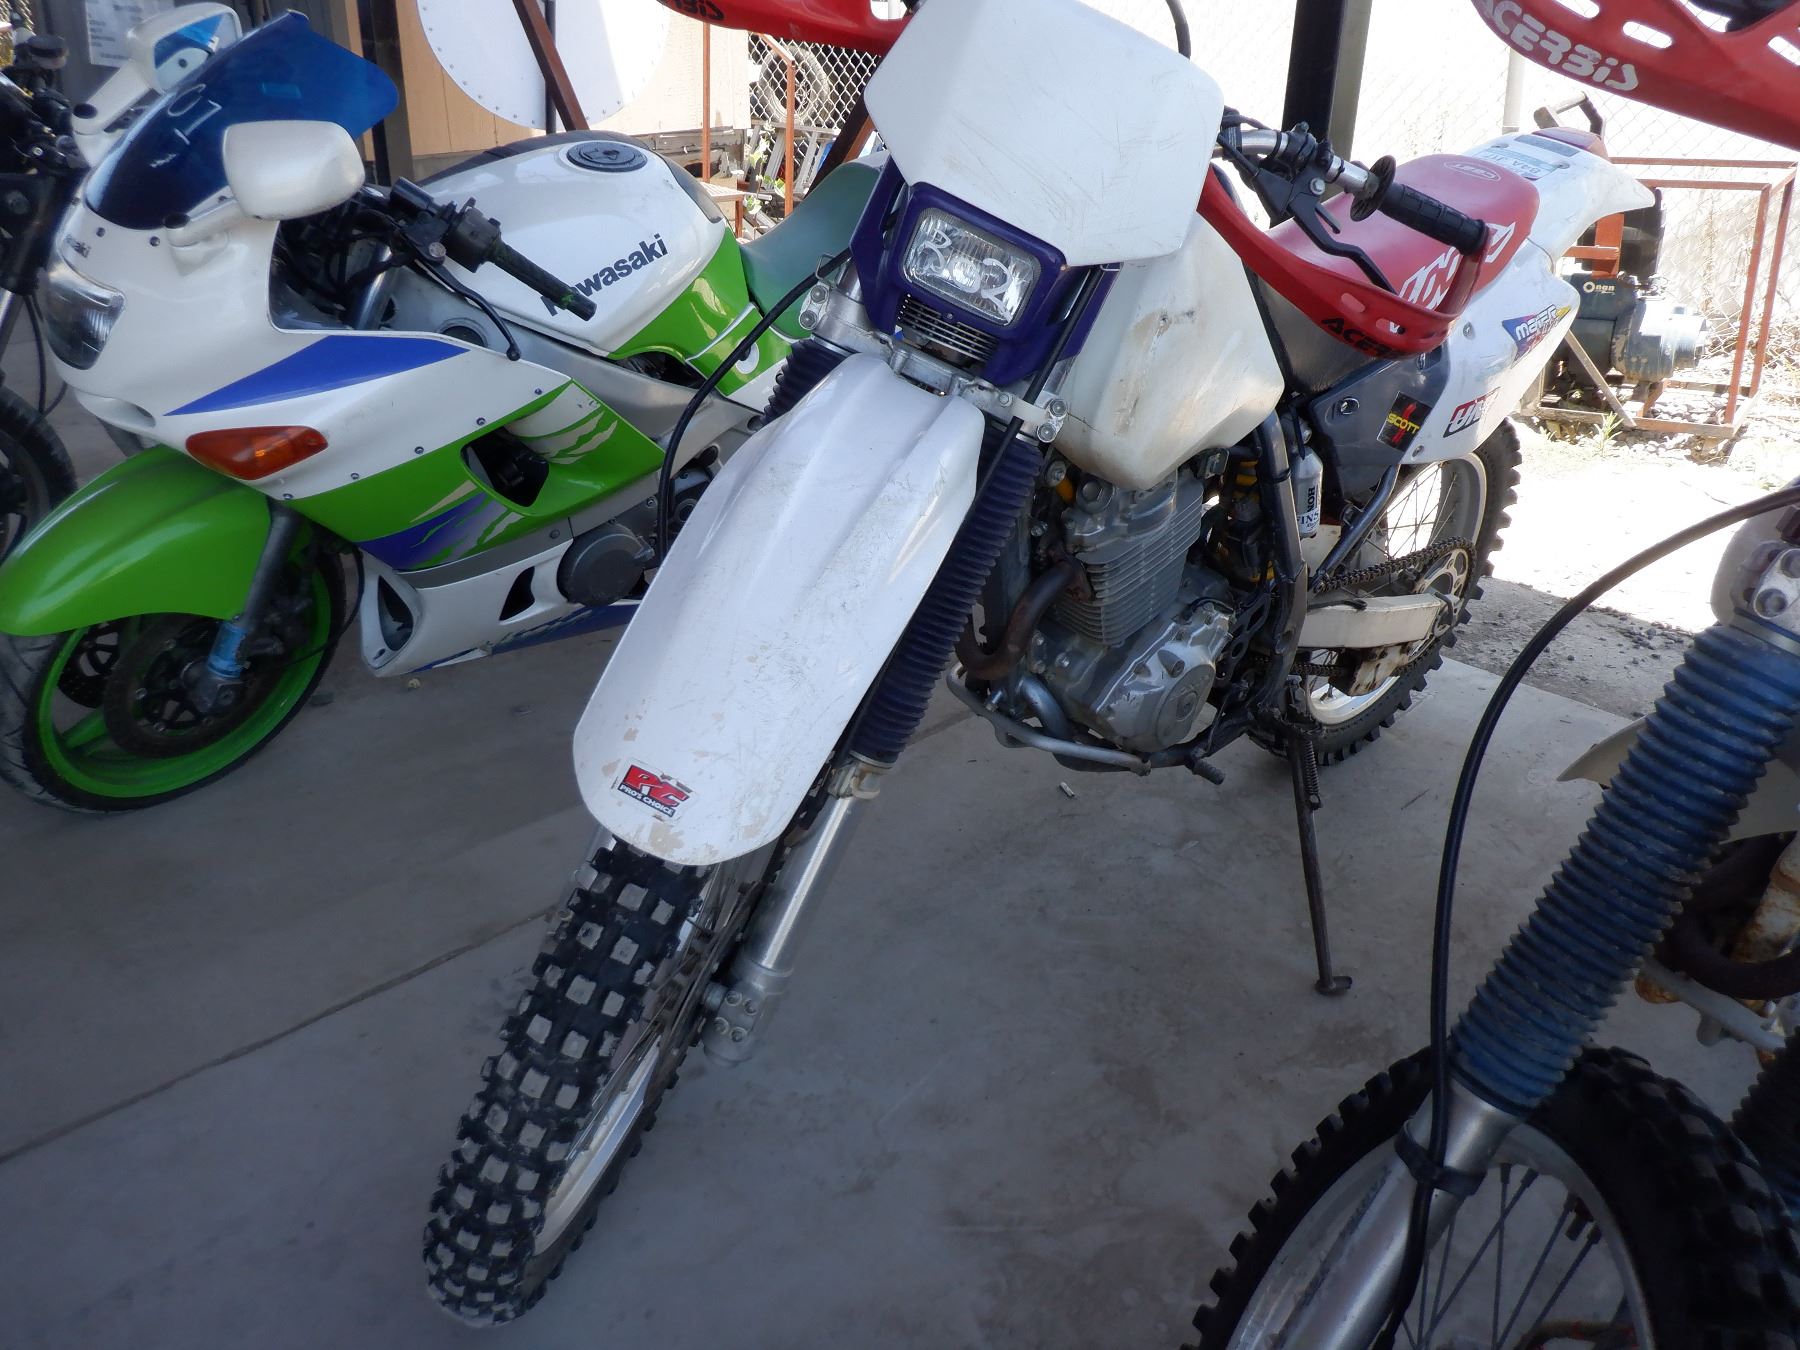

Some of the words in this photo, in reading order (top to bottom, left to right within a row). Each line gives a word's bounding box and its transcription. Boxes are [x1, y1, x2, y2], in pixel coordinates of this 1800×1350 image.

[540, 233, 668, 317] wasaki
[1387, 412, 1420, 435] SCOTT
[619, 784, 643, 800] PRO'S
[643, 796, 676, 817] CHOICE
